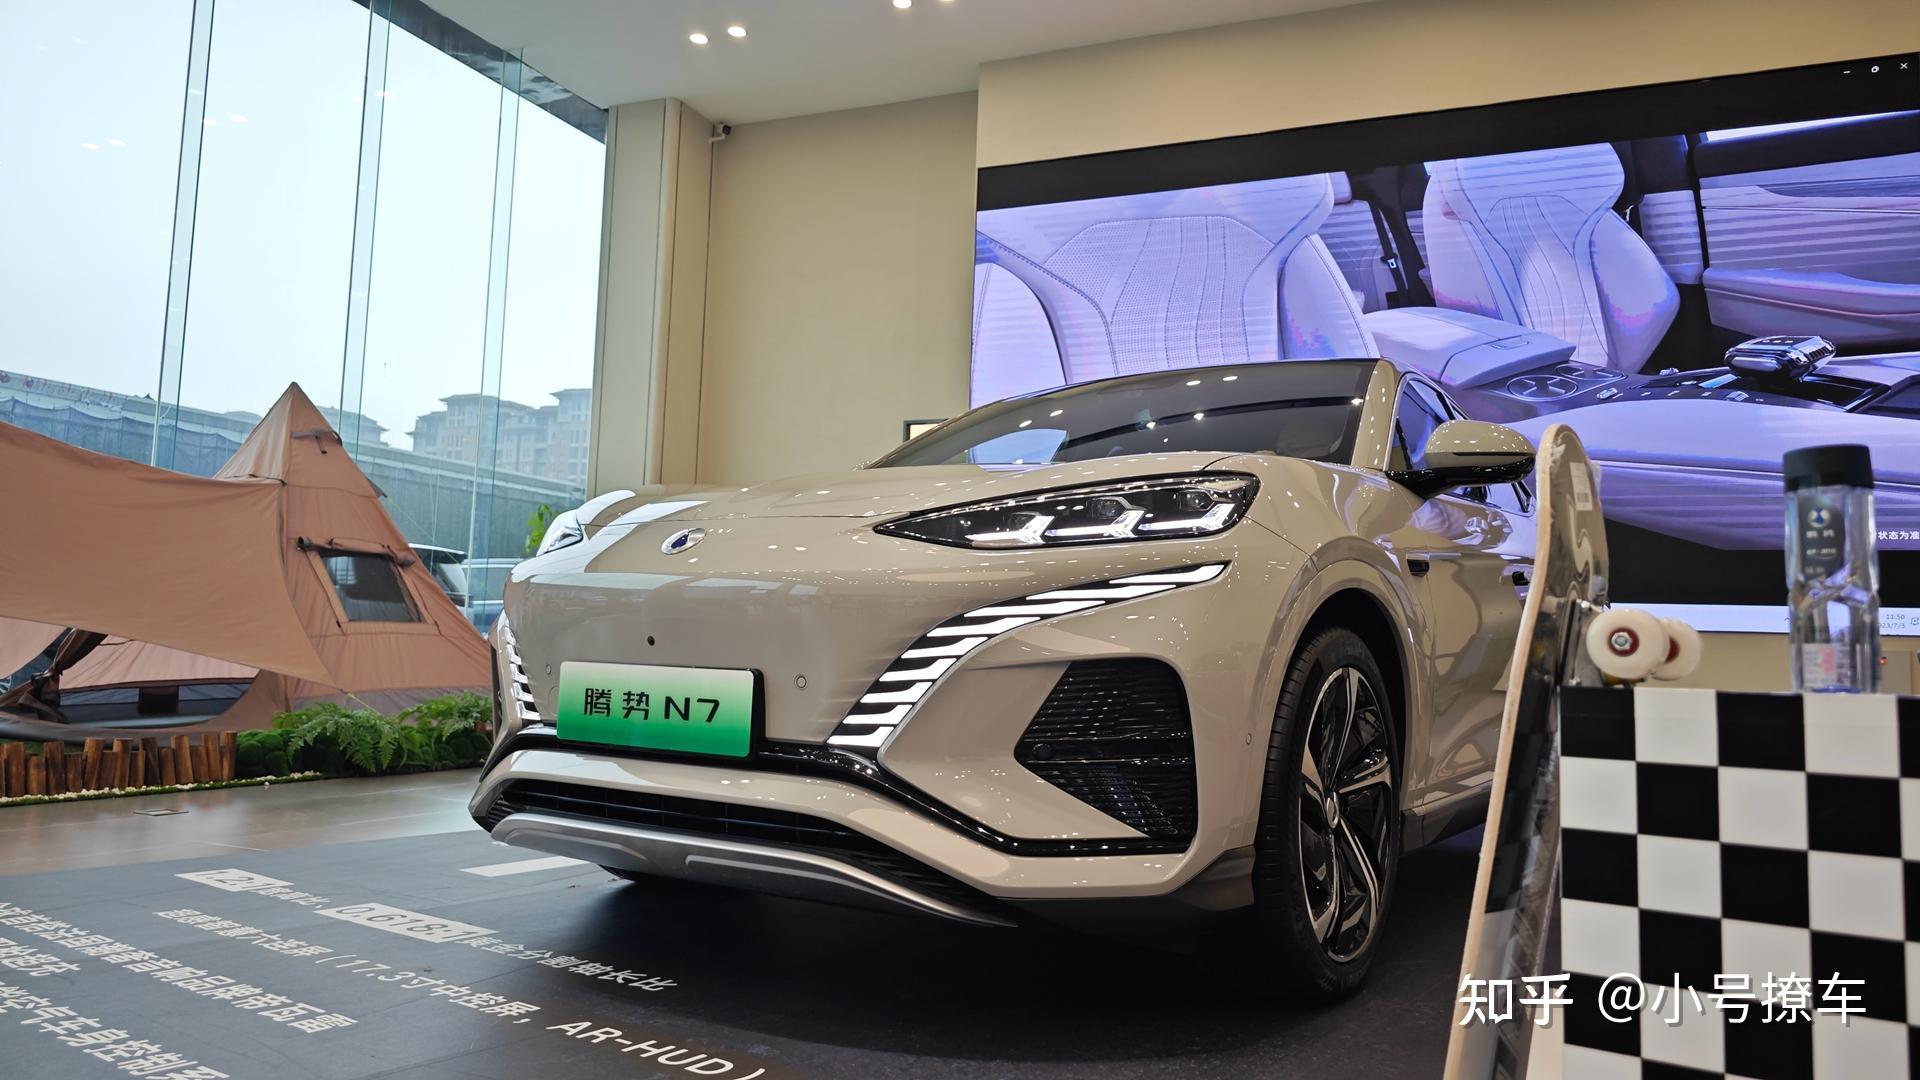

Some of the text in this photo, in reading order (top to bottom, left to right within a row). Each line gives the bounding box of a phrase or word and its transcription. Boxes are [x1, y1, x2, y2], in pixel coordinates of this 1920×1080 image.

[1877, 530, 1920, 540] 状态为准
[0, 981, 231, 1080] 能空气车身控制系
